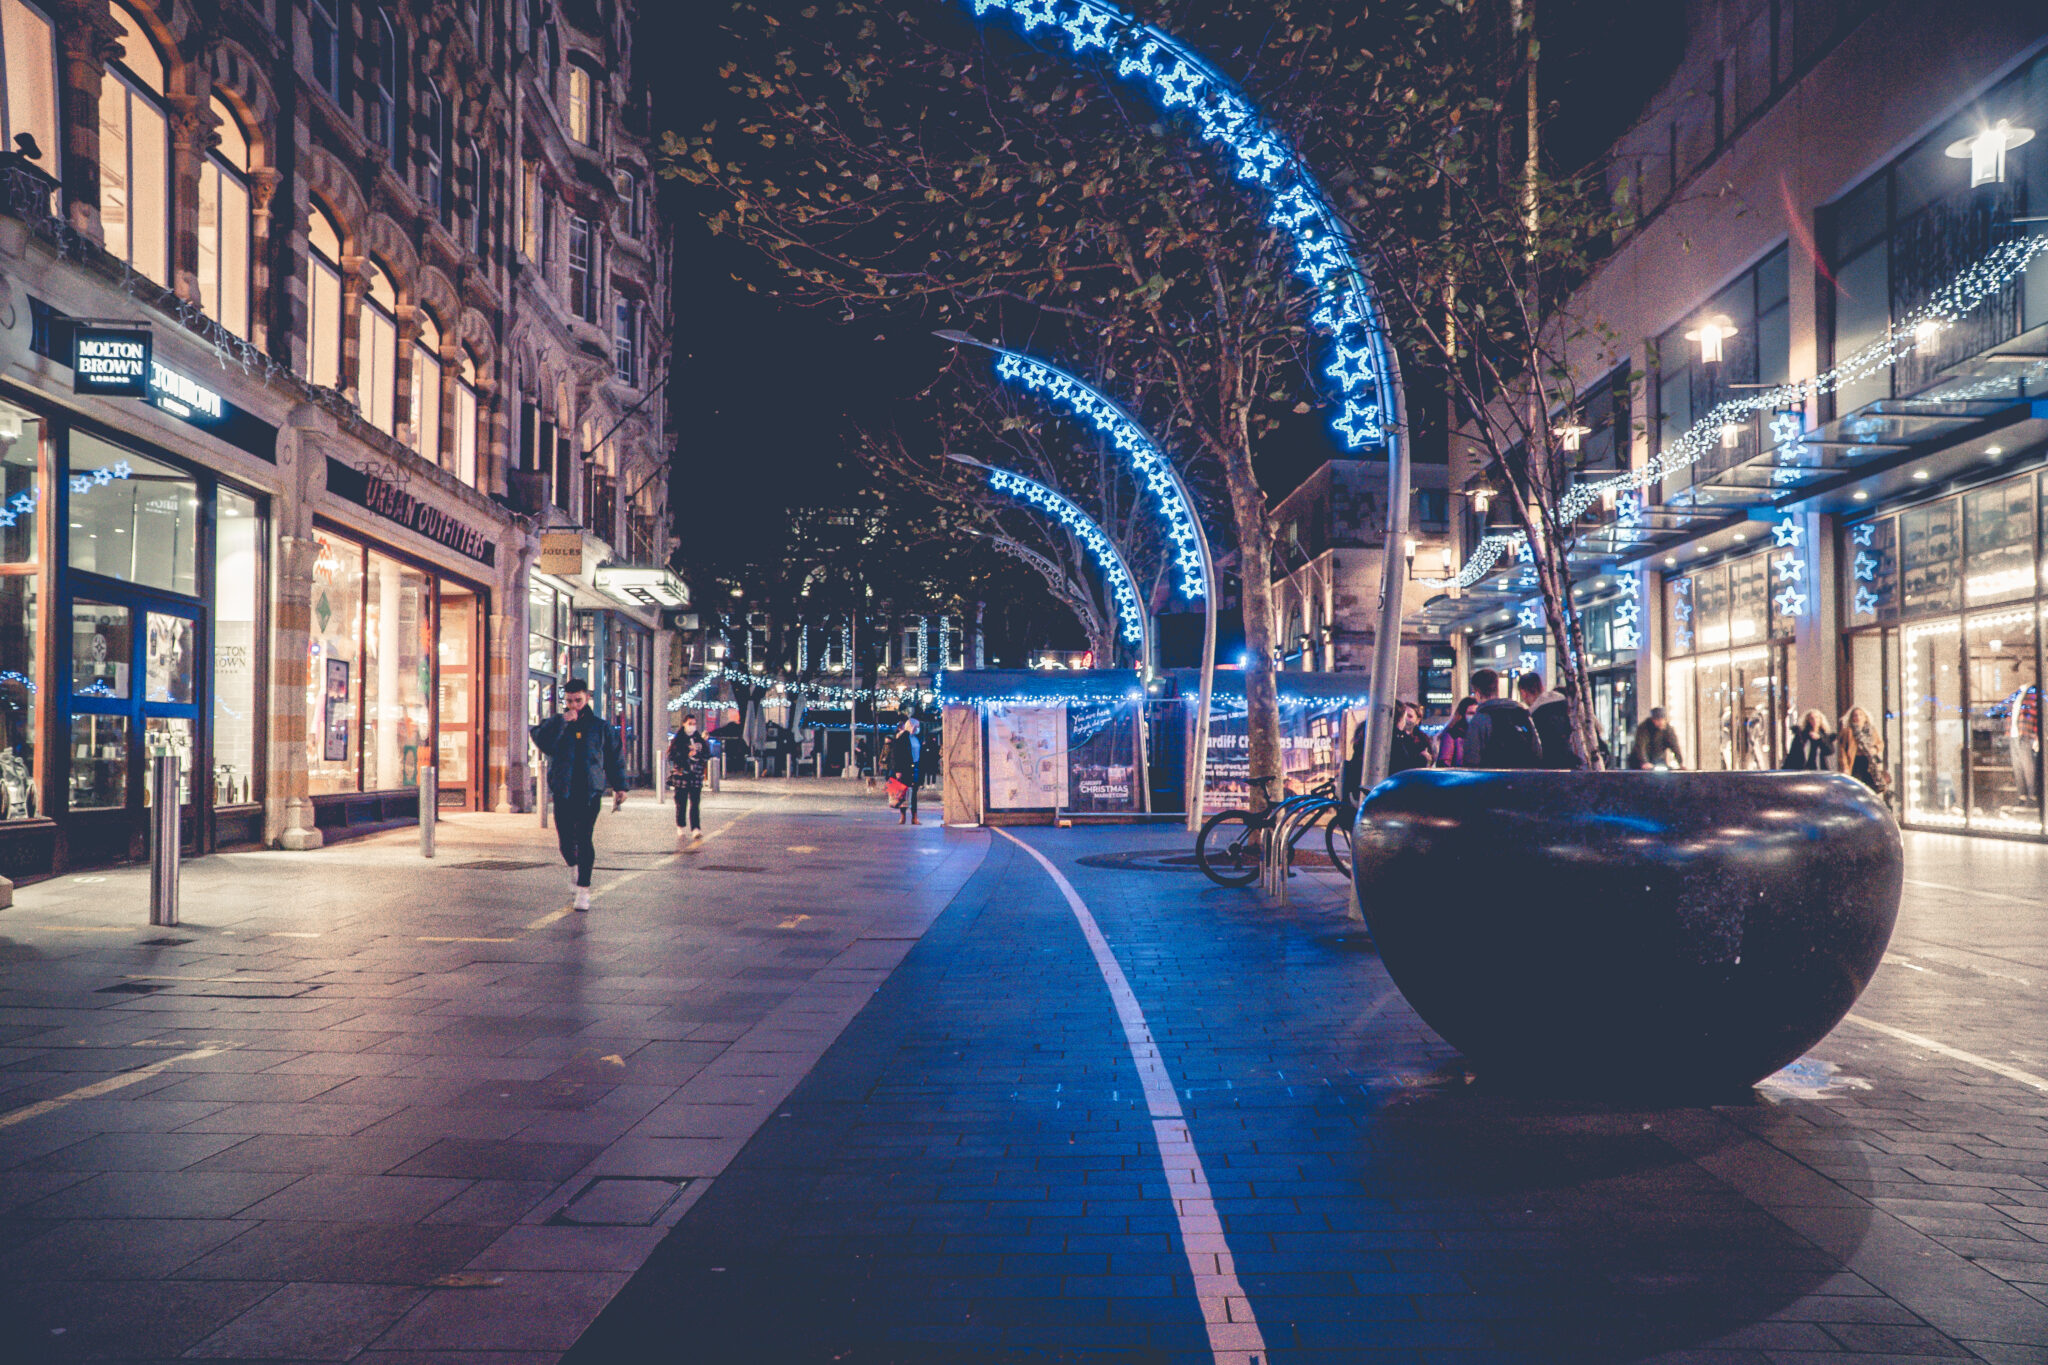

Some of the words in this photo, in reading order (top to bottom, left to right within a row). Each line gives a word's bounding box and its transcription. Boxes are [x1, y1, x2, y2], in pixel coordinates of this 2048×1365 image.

[79, 340, 144, 359] MOLTON
[79, 357, 143, 375] BROWN
[366, 474, 417, 526] URBAN
[418, 504, 486, 560] OUTFITTERS
[542, 547, 582, 557] JOULES
[1522, 634, 1544, 645] VANS
[1432, 658, 1453, 668] BOSS
[1096, 708, 1111, 717] here
[1207, 735, 1237, 749] ardiff
[1293, 736, 1332, 749] Market
[1079, 785, 1129, 794] CHRISTMAS
